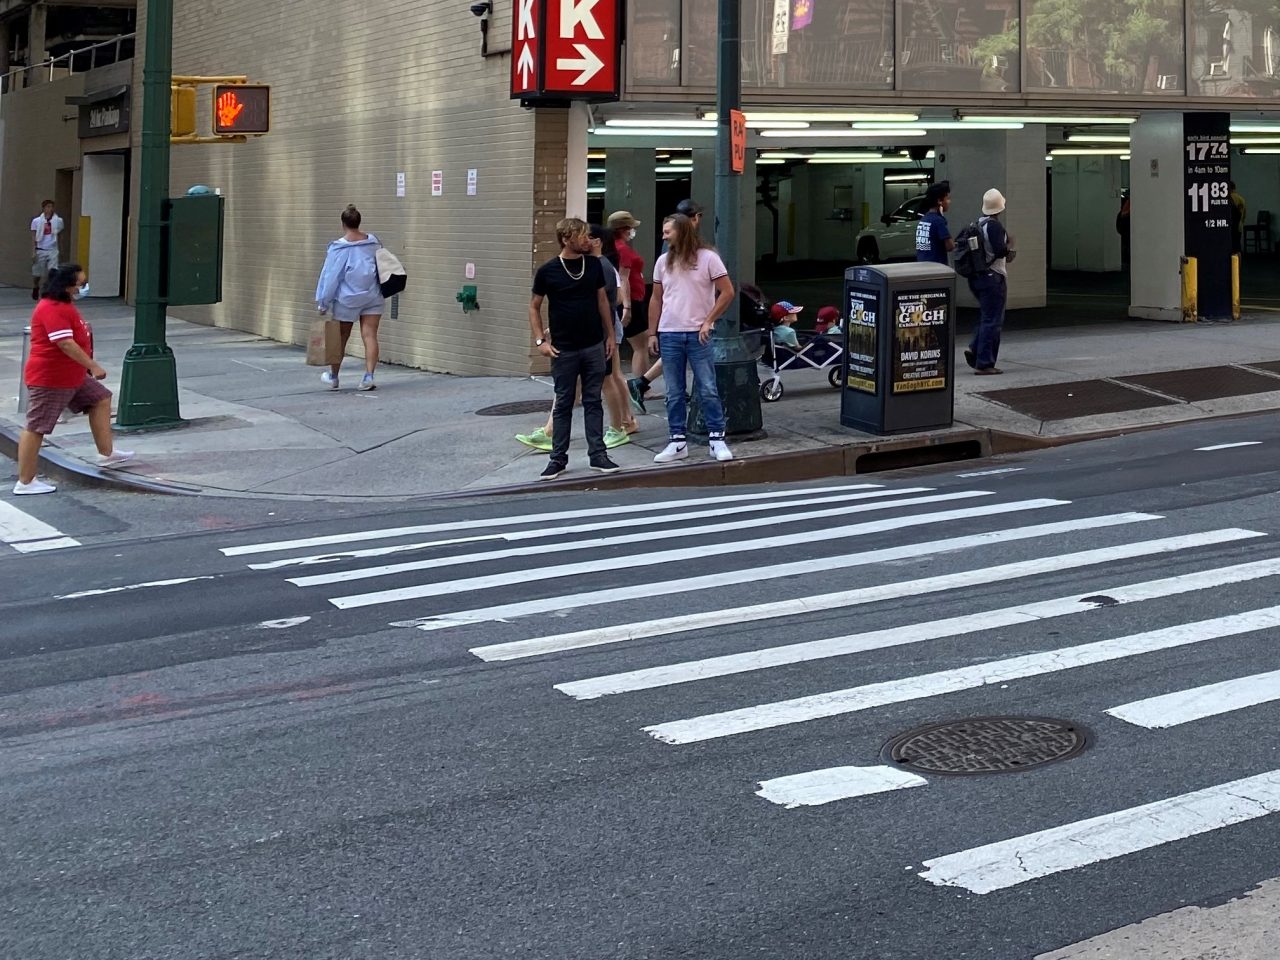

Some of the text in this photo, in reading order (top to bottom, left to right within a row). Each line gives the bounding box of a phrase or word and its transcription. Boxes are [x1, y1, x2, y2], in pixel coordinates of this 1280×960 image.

[1205, 220, 1215, 228] 1/2
[901, 349, 941, 361] DAVID KORINS
